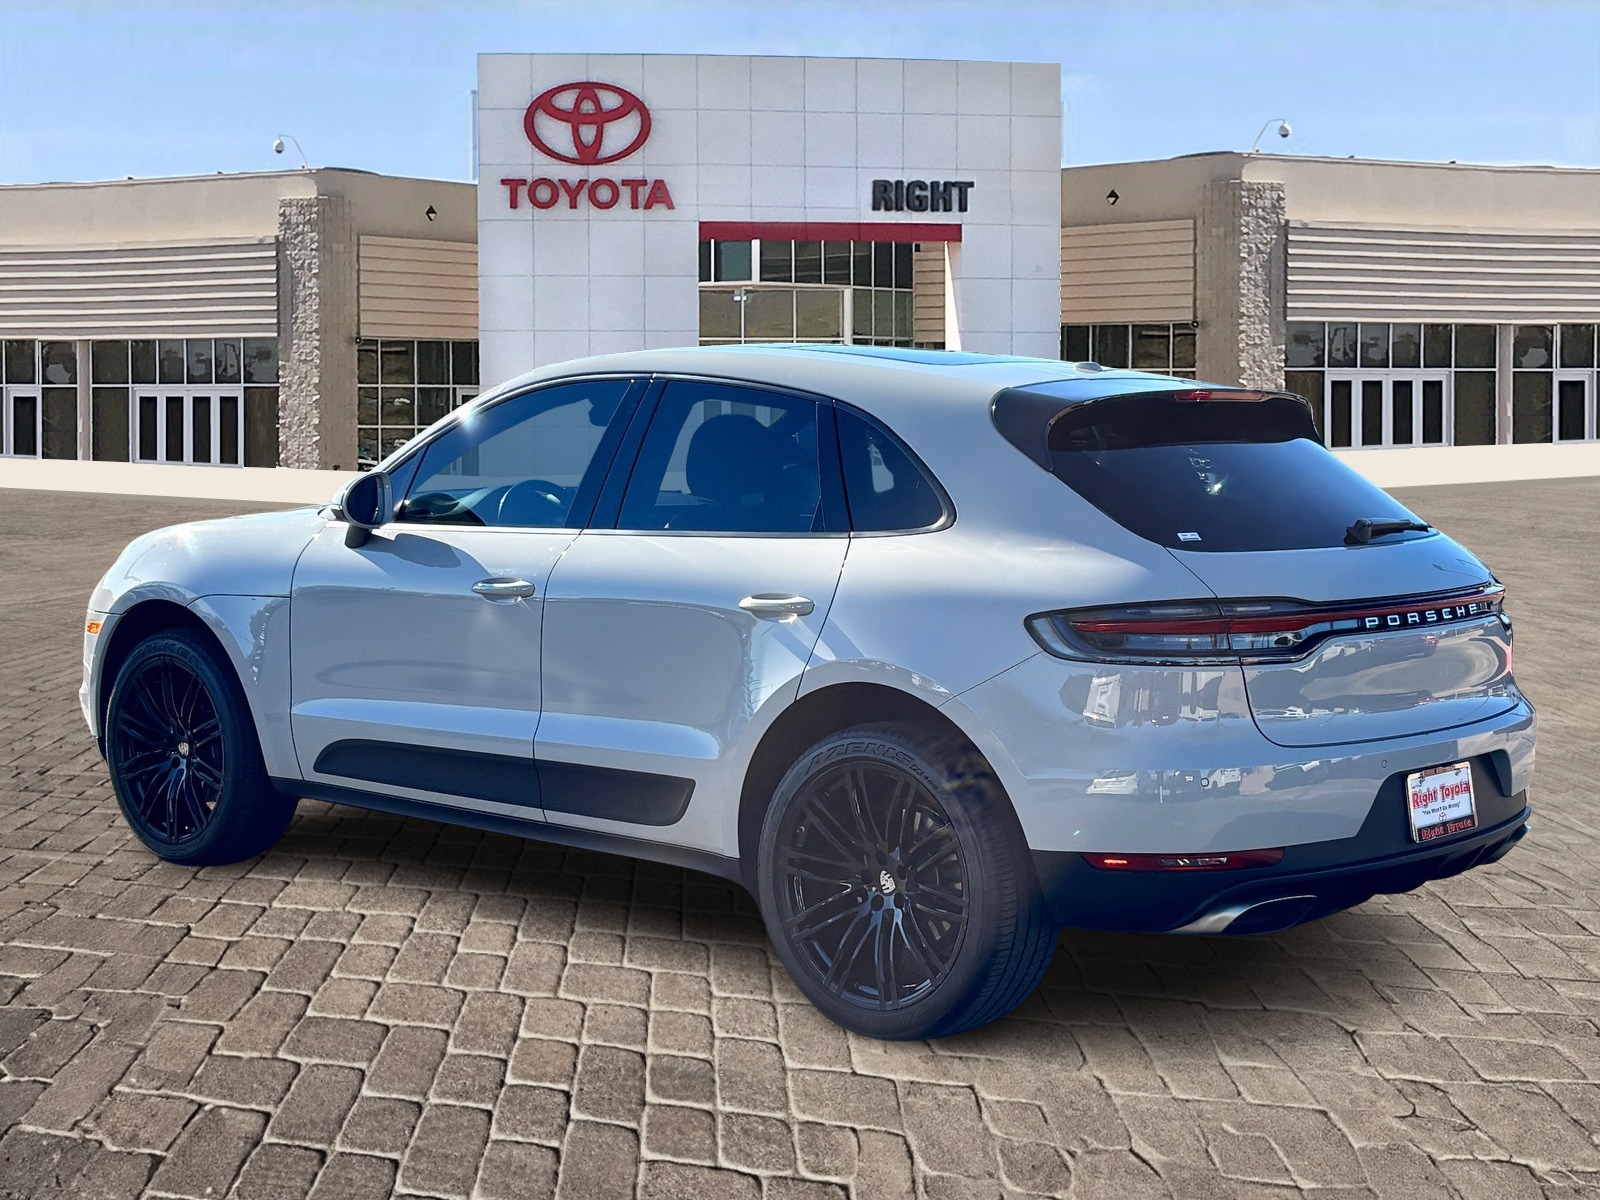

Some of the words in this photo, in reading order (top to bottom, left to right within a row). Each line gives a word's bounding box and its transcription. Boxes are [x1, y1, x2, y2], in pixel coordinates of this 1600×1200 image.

[500, 177, 675, 210] TOYOTA
[872, 179, 975, 212] RIGHT
[1365, 603, 1478, 629] PORSCHE
[1412, 786, 1438, 809] Right
[1440, 780, 1470, 803] Toyota
